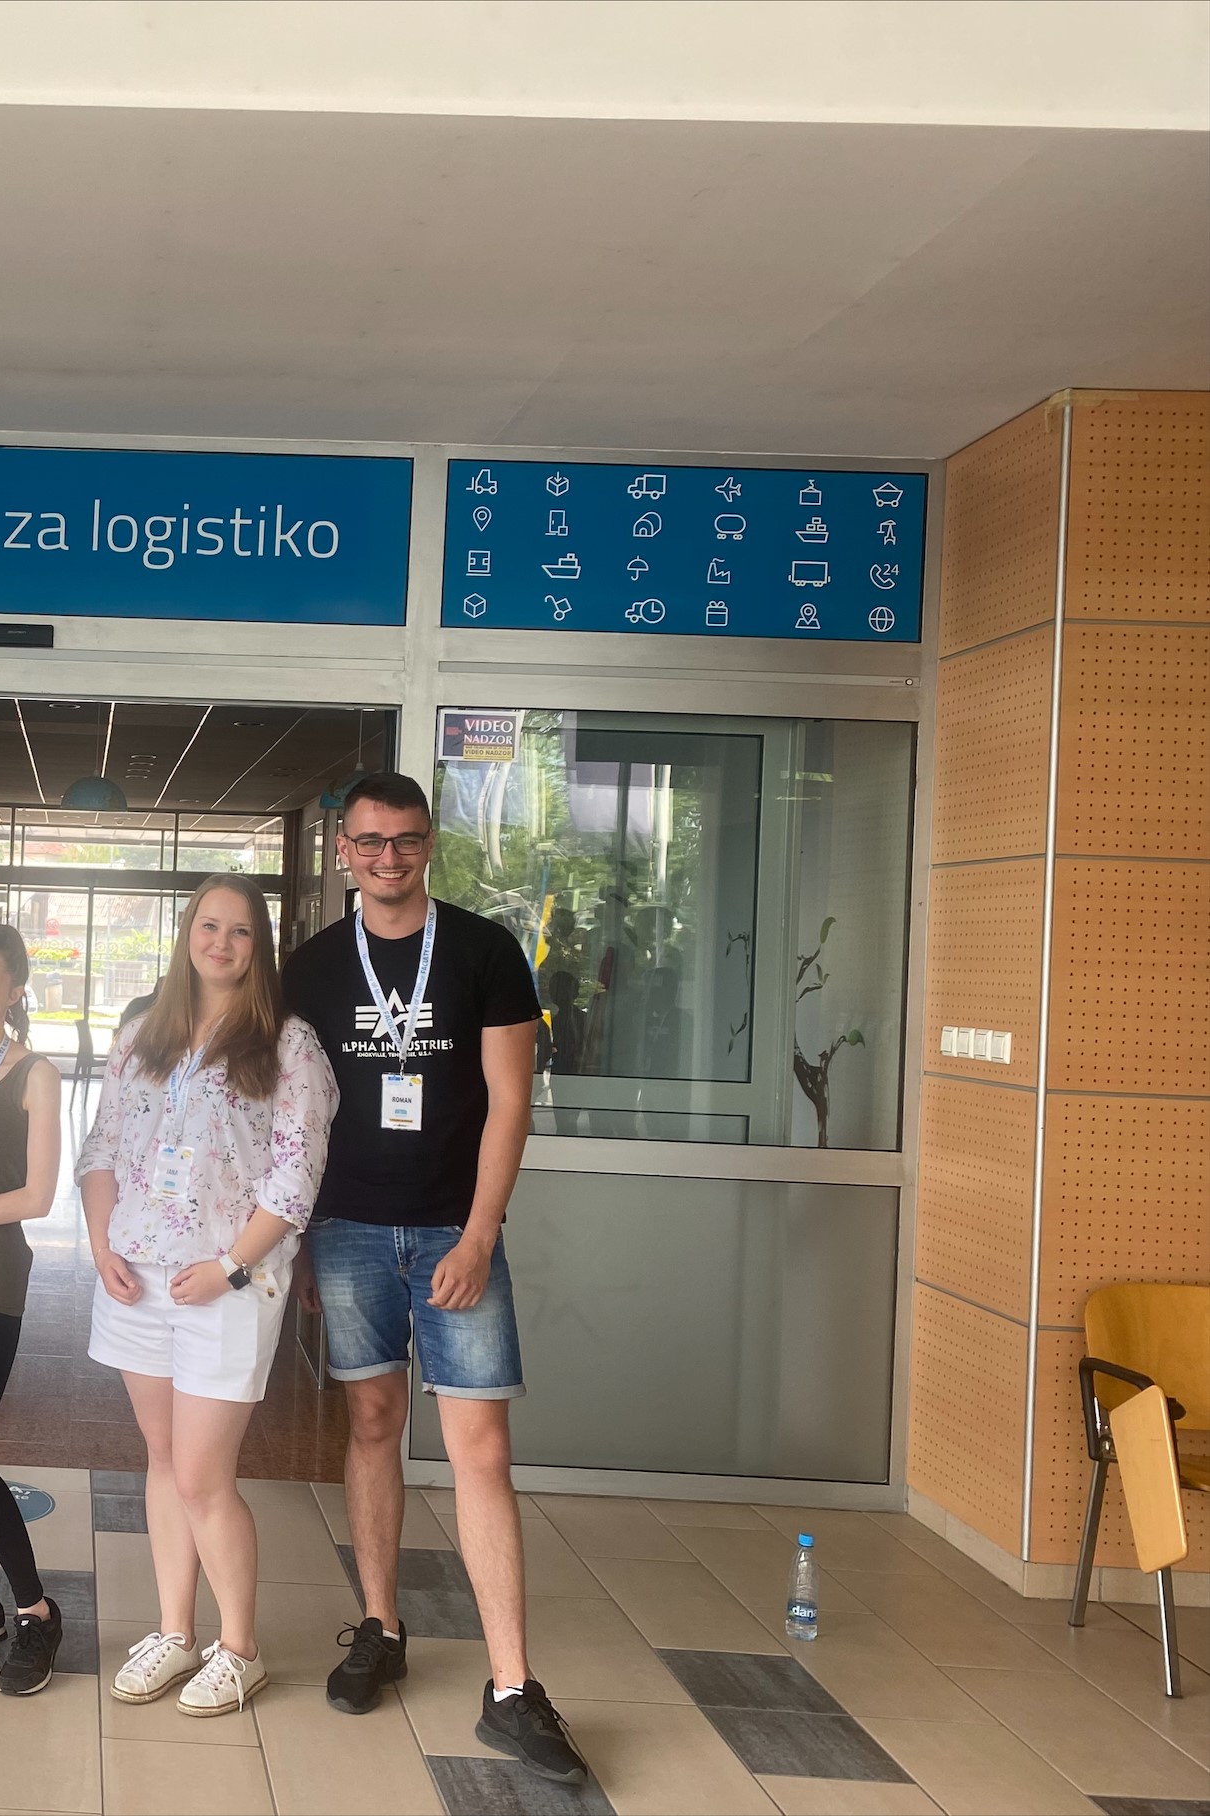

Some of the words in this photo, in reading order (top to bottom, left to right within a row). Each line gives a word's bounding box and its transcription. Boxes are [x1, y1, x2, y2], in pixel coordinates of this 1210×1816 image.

[3, 508, 69, 551] za
[91, 499, 340, 569] logistiko
[883, 563, 900, 576] 24
[464, 719, 514, 733] VIDEO
[463, 733, 513, 745] NADZOR
[425, 911, 435, 939] LOGISTICS
[424, 939, 431, 948] OF
[419, 948, 430, 973] FACULTY
[414, 973, 425, 998] Maribor
[361, 953, 375, 982] University
[372, 987, 387, 1011] Maribor
[382, 1010, 398, 1036] FACULTY
[412, 997, 420, 1005] of
[405, 1004, 419, 1037] University
[381, 1038, 454, 1052] INUSTRIES
[392, 1096, 412, 1104] ROMAN
